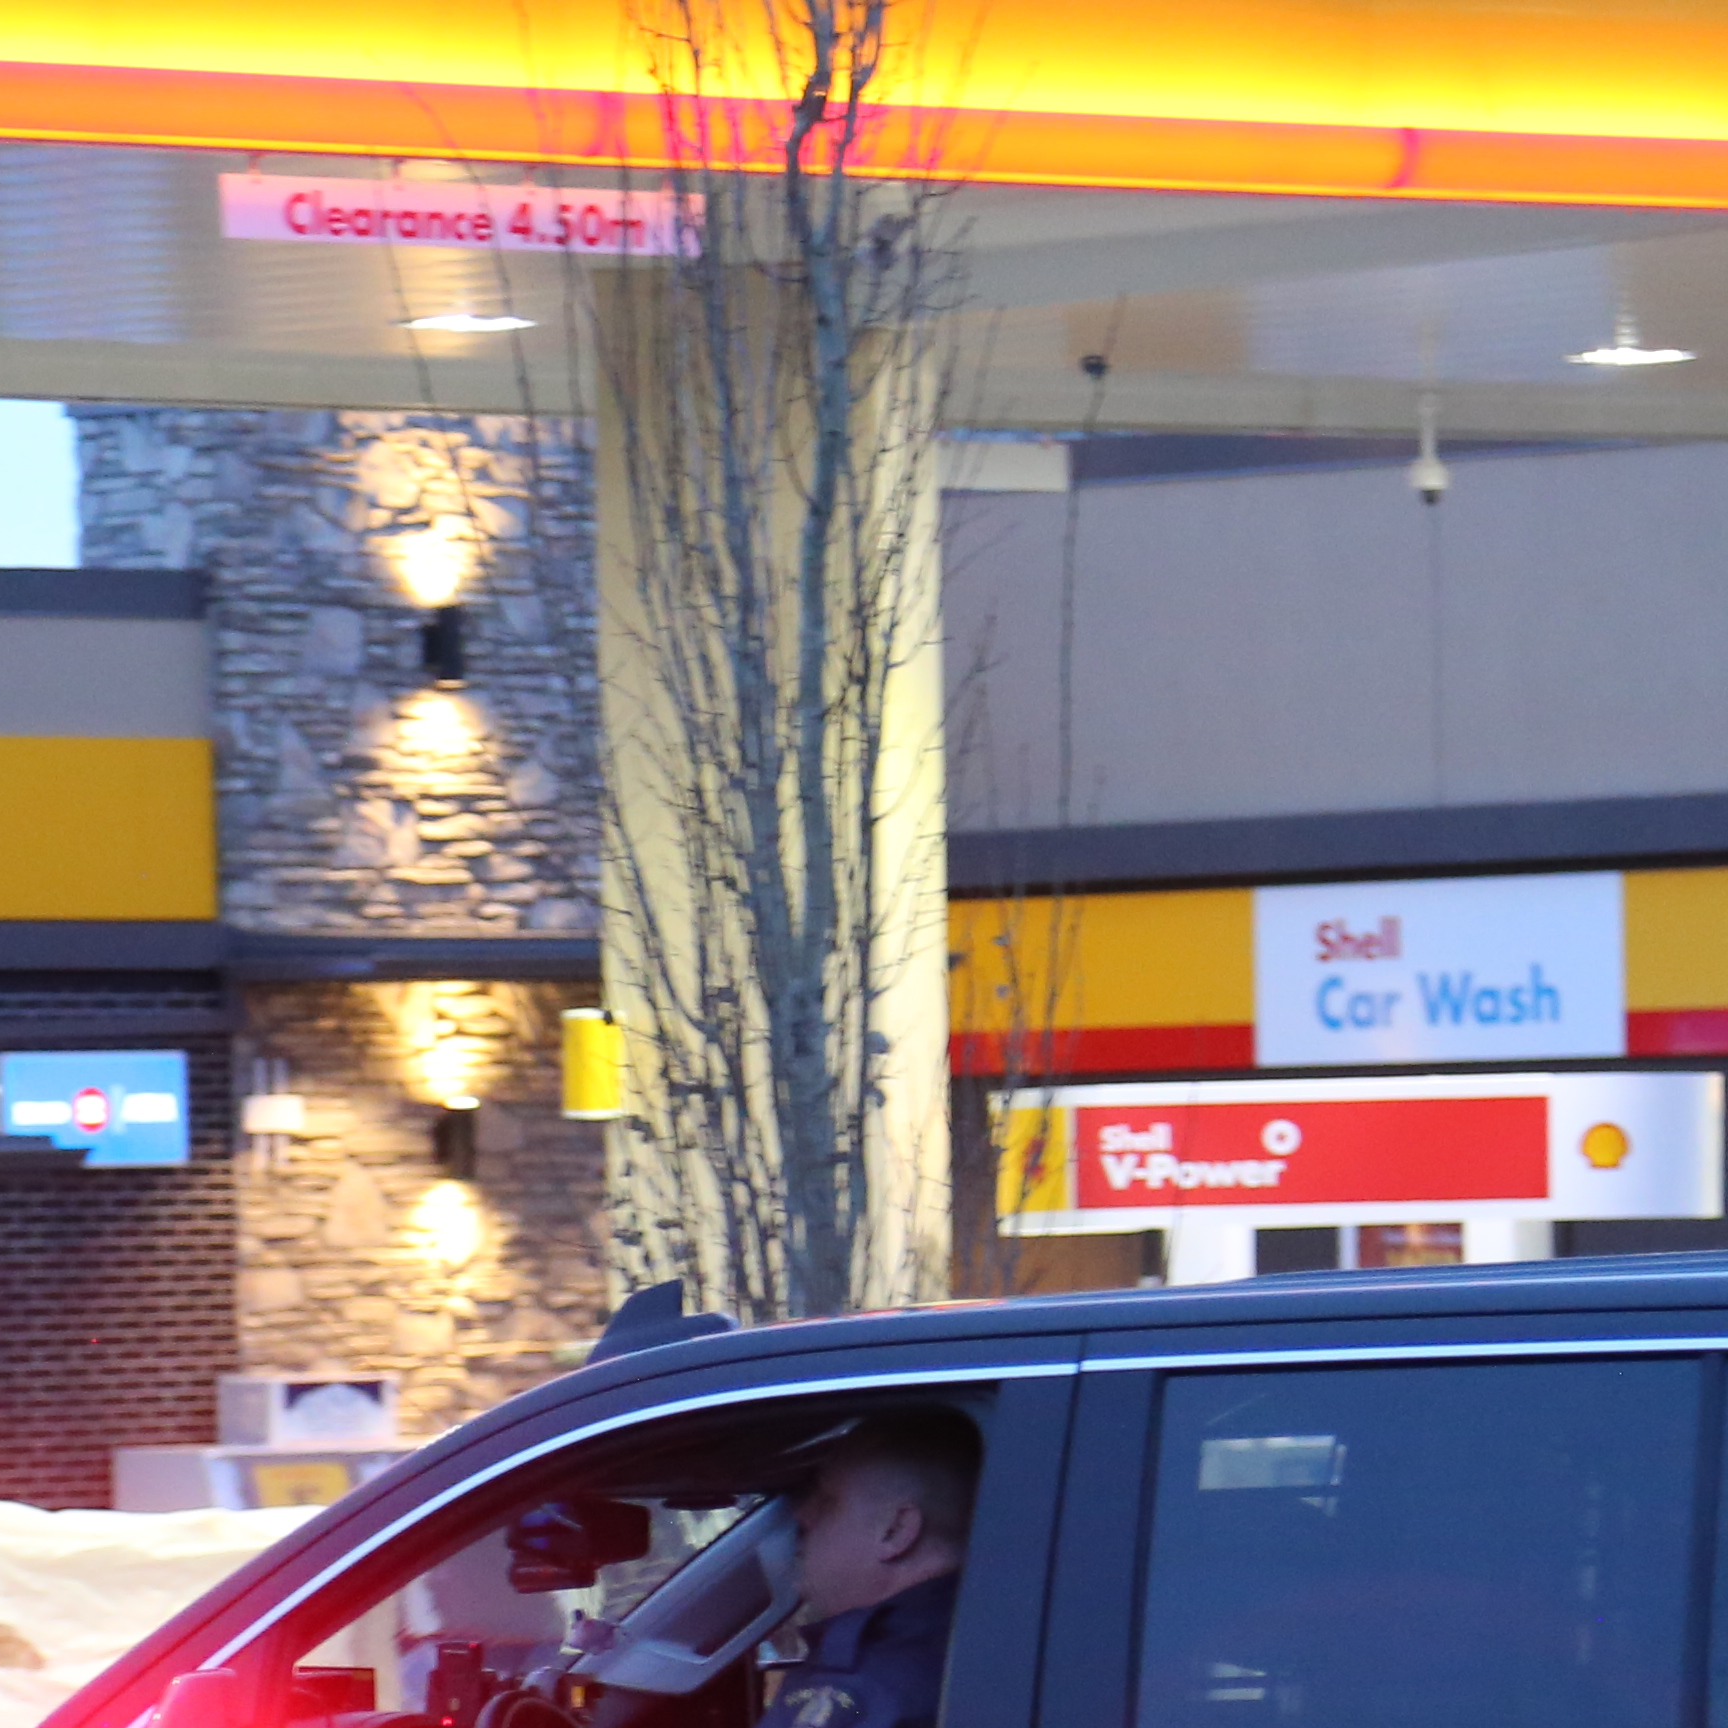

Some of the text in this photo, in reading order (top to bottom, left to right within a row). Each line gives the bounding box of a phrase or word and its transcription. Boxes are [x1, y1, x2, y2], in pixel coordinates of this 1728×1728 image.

[284, 191, 646, 248] Clearance 4.50m
[1314, 915, 1403, 962] Shell
[1315, 961, 1562, 1031] Car Wash
[1097, 1121, 1174, 1152] Shell
[1099, 1152, 1289, 1190] V-Power
